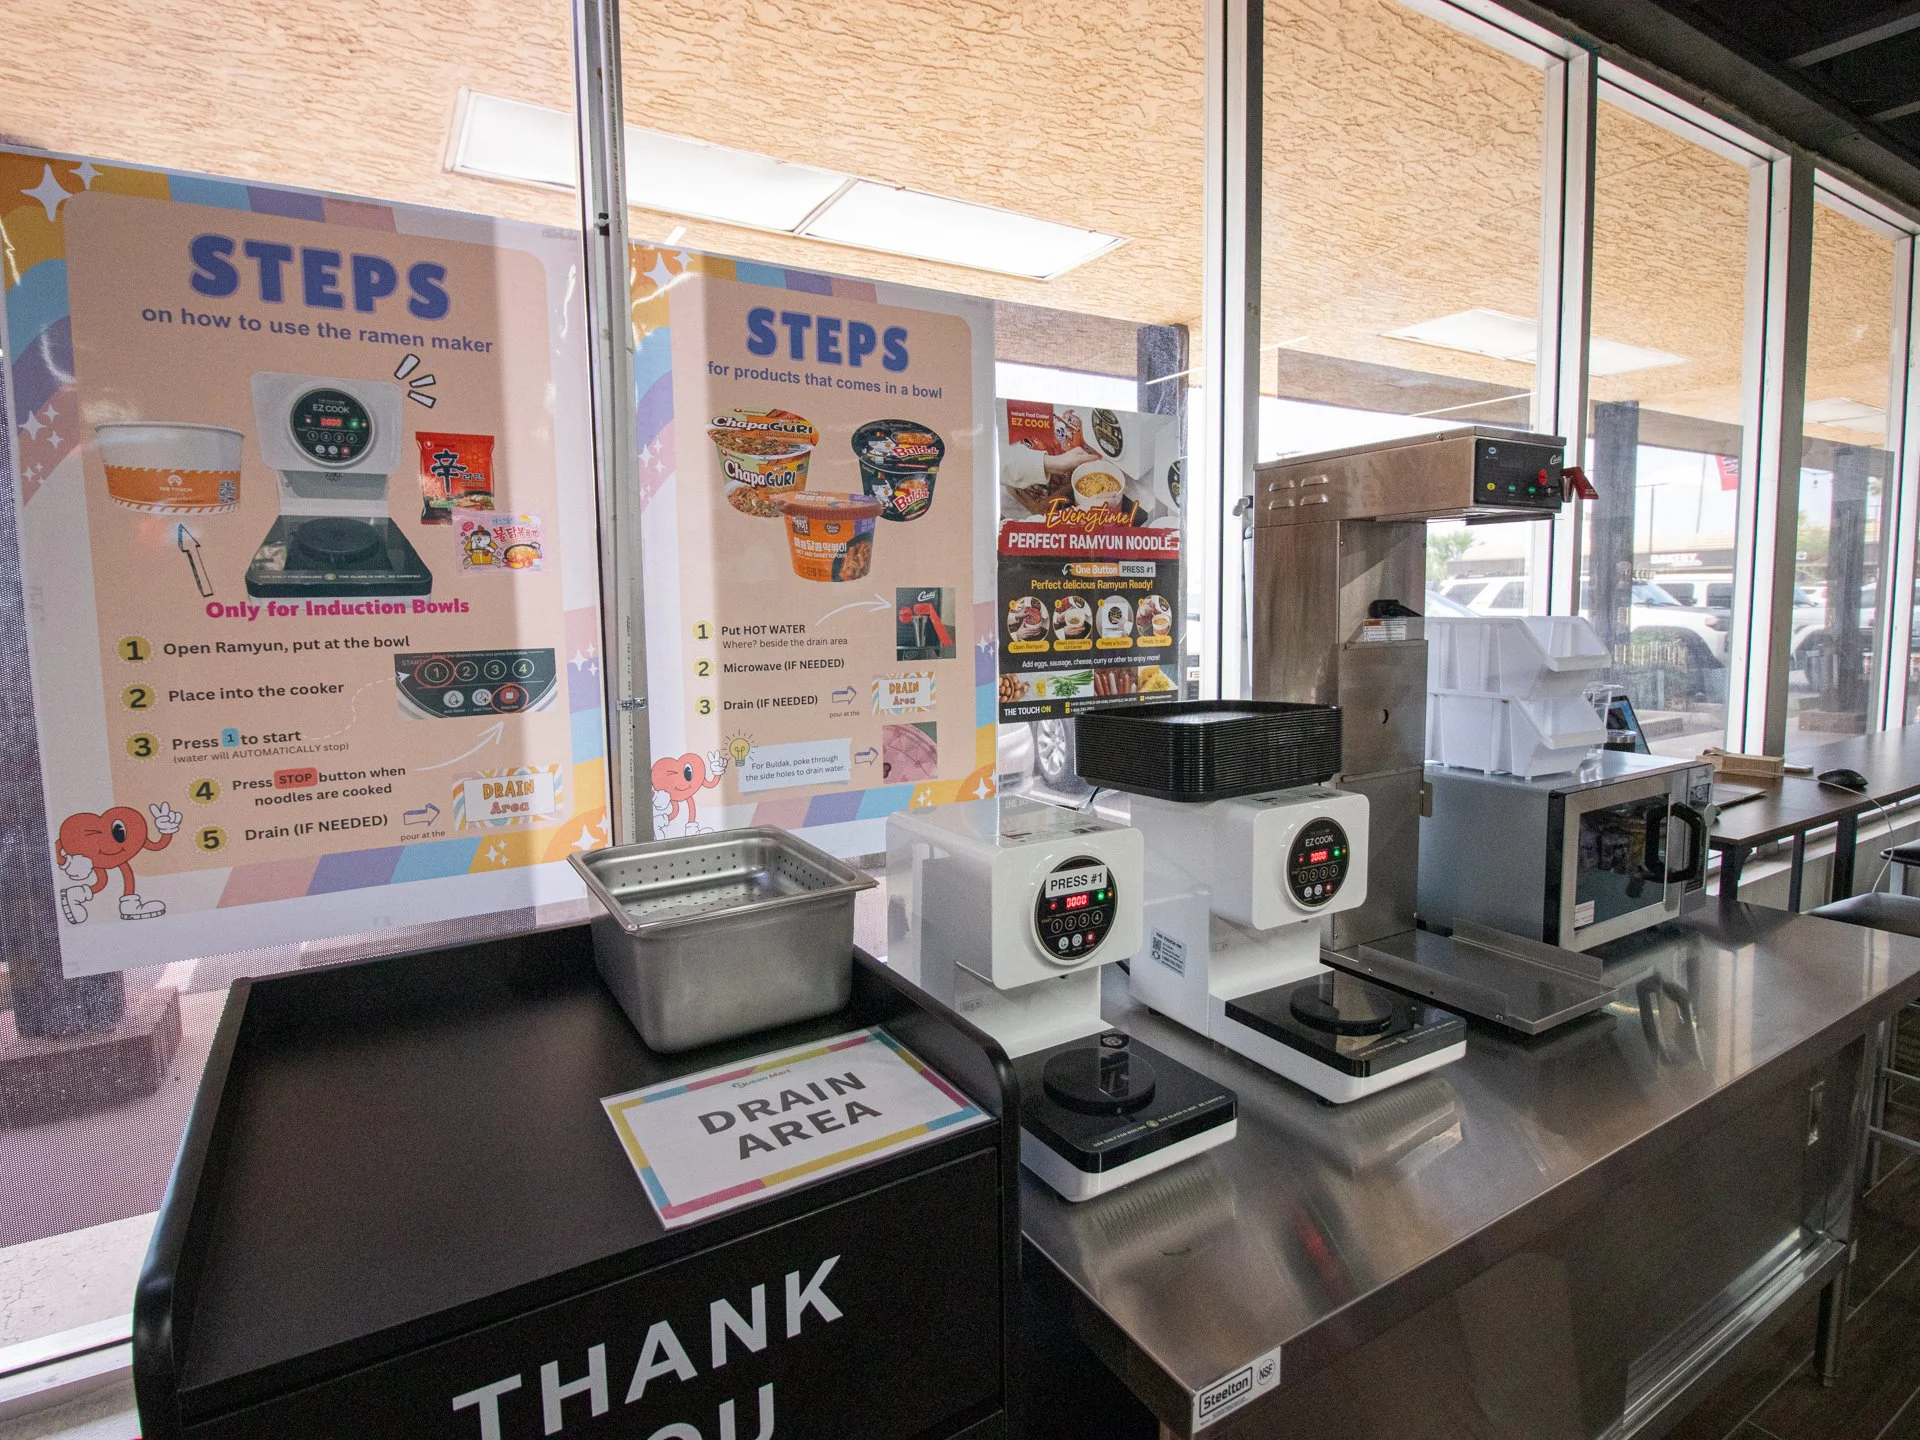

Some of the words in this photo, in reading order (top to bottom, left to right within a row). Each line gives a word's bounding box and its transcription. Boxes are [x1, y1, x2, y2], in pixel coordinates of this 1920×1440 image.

[189, 233, 451, 320] STEPS
[142, 308, 173, 323] on
[181, 308, 232, 329] how
[239, 315, 262, 331] to
[270, 320, 310, 336] use
[317, 322, 351, 340] the
[359, 330, 424, 347] ramen
[432, 335, 493, 353] maker
[746, 305, 909, 373] STEPS
[707, 361, 729, 376] for
[734, 363, 801, 384] products
[805, 372, 832, 387] that
[836, 379, 881, 393] comes
[885, 382, 897, 395] in
[900, 386, 909, 396] a
[912, 384, 942, 399] bowl
[313, 404, 324, 412] EZ
[325, 405, 349, 413] COOK
[1011, 418, 1023, 427] EZ
[1025, 419, 1050, 429] COOK
[430, 449, 467, 495] 辛
[1046, 497, 1140, 533] Everytime!
[1008, 532, 1067, 549] PERFECT
[1069, 534, 1123, 550] RAMYUN
[1075, 564, 1091, 574] One
[1092, 564, 1118, 574] Button
[1122, 565, 1145, 574] PRESS
[1146, 565, 1154, 574] #1
[1031, 579, 1062, 590] Perfect
[1063, 579, 1096, 590] delicious
[1097, 580, 1128, 592] Ramyun
[1129, 579, 1153, 592] Ready!
[206, 602, 260, 621] Only
[268, 601, 299, 617] for
[306, 599, 405, 616] Induction
[412, 598, 469, 614] Bowls
[697, 623, 709, 640] 1
[721, 626, 741, 636] Put
[744, 625, 767, 635] HOT
[769, 624, 806, 634] WATER
[126, 640, 144, 661] 1
[163, 641, 211, 657] Open
[216, 640, 288, 655] Ramyun,
[293, 640, 320, 653] put
[324, 638, 340, 649] at
[343, 637, 370, 649] the
[373, 636, 410, 648] bowl
[722, 639, 757, 649] Where?
[759, 639, 788, 648] beside
[790, 638, 804, 647] the
[806, 637, 828, 647] drain
[830, 638, 848, 646] area
[698, 661, 709, 677] 2
[723, 662, 782, 673] Microwave
[784, 660, 797, 672] (IF
[800, 658, 845, 670] NEEDED)
[1074, 658, 1093, 666] cheese,
[1133, 655, 1146, 663] enjoy
[433, 667, 440, 678] 1
[463, 666, 471, 677] 2
[491, 665, 500, 675] 3
[519, 663, 528, 674] 4
[129, 688, 147, 709] 2
[168, 690, 216, 702] Place
[220, 687, 254, 699] into
[258, 684, 286, 697] the
[290, 682, 345, 695] cooker
[889, 681, 920, 695] DRAIN
[700, 699, 711, 715] 3
[723, 700, 754, 711] Drain
[756, 698, 770, 710] (IF
[772, 695, 818, 707] NEEDED)
[893, 695, 916, 706] Area
[1004, 708, 1017, 716] THE
[1018, 707, 1041, 715] TOUCH
[133, 737, 152, 757] 3
[172, 738, 219, 750] Press
[226, 733, 235, 743] 1
[240, 734, 258, 745] to
[263, 731, 301, 743] start
[173, 753, 207, 764] (water
[211, 752, 230, 761] will
[232, 744, 321, 759] AUTOMATICALLY
[323, 742, 349, 753] stop)
[752, 762, 764, 770] For
[766, 759, 792, 770] Buldak,
[793, 758, 809, 768] poke
[811, 754, 839, 766] through
[745, 774, 759, 782] the
[760, 772, 775, 781] side
[776, 769, 795, 779] holes
[805, 767, 823, 776] drain
[824, 765, 845, 773] water.
[195, 781, 215, 801] 4
[232, 779, 273, 791] Press
[279, 773, 313, 785] STOP
[318, 770, 367, 783] button
[370, 767, 406, 779] when
[482, 779, 535, 800] DRAIN
[254, 791, 313, 807] noodles
[316, 789, 339, 801] are
[342, 783, 392, 798] cooked
[490, 801, 530, 815] Area
[202, 829, 220, 849] 5
[245, 826, 289, 841] Drain
[293, 822, 315, 837] (IF
[318, 814, 388, 833] NEEDED)
[400, 832, 420, 842] pour
[432, 829, 446, 838] the
[1305, 838, 1314, 847] EZ
[1315, 834, 1334, 845] COOK
[1051, 874, 1088, 891] PRESS
[1091, 873, 1103, 884] #1
[698, 1071, 867, 1136] DRAIN
[739, 1101, 883, 1160] AREA
[452, 1254, 844, 1440] THANK
[1259, 1363, 1273, 1380] NSF
[1203, 1377, 1249, 1410] Steelton
